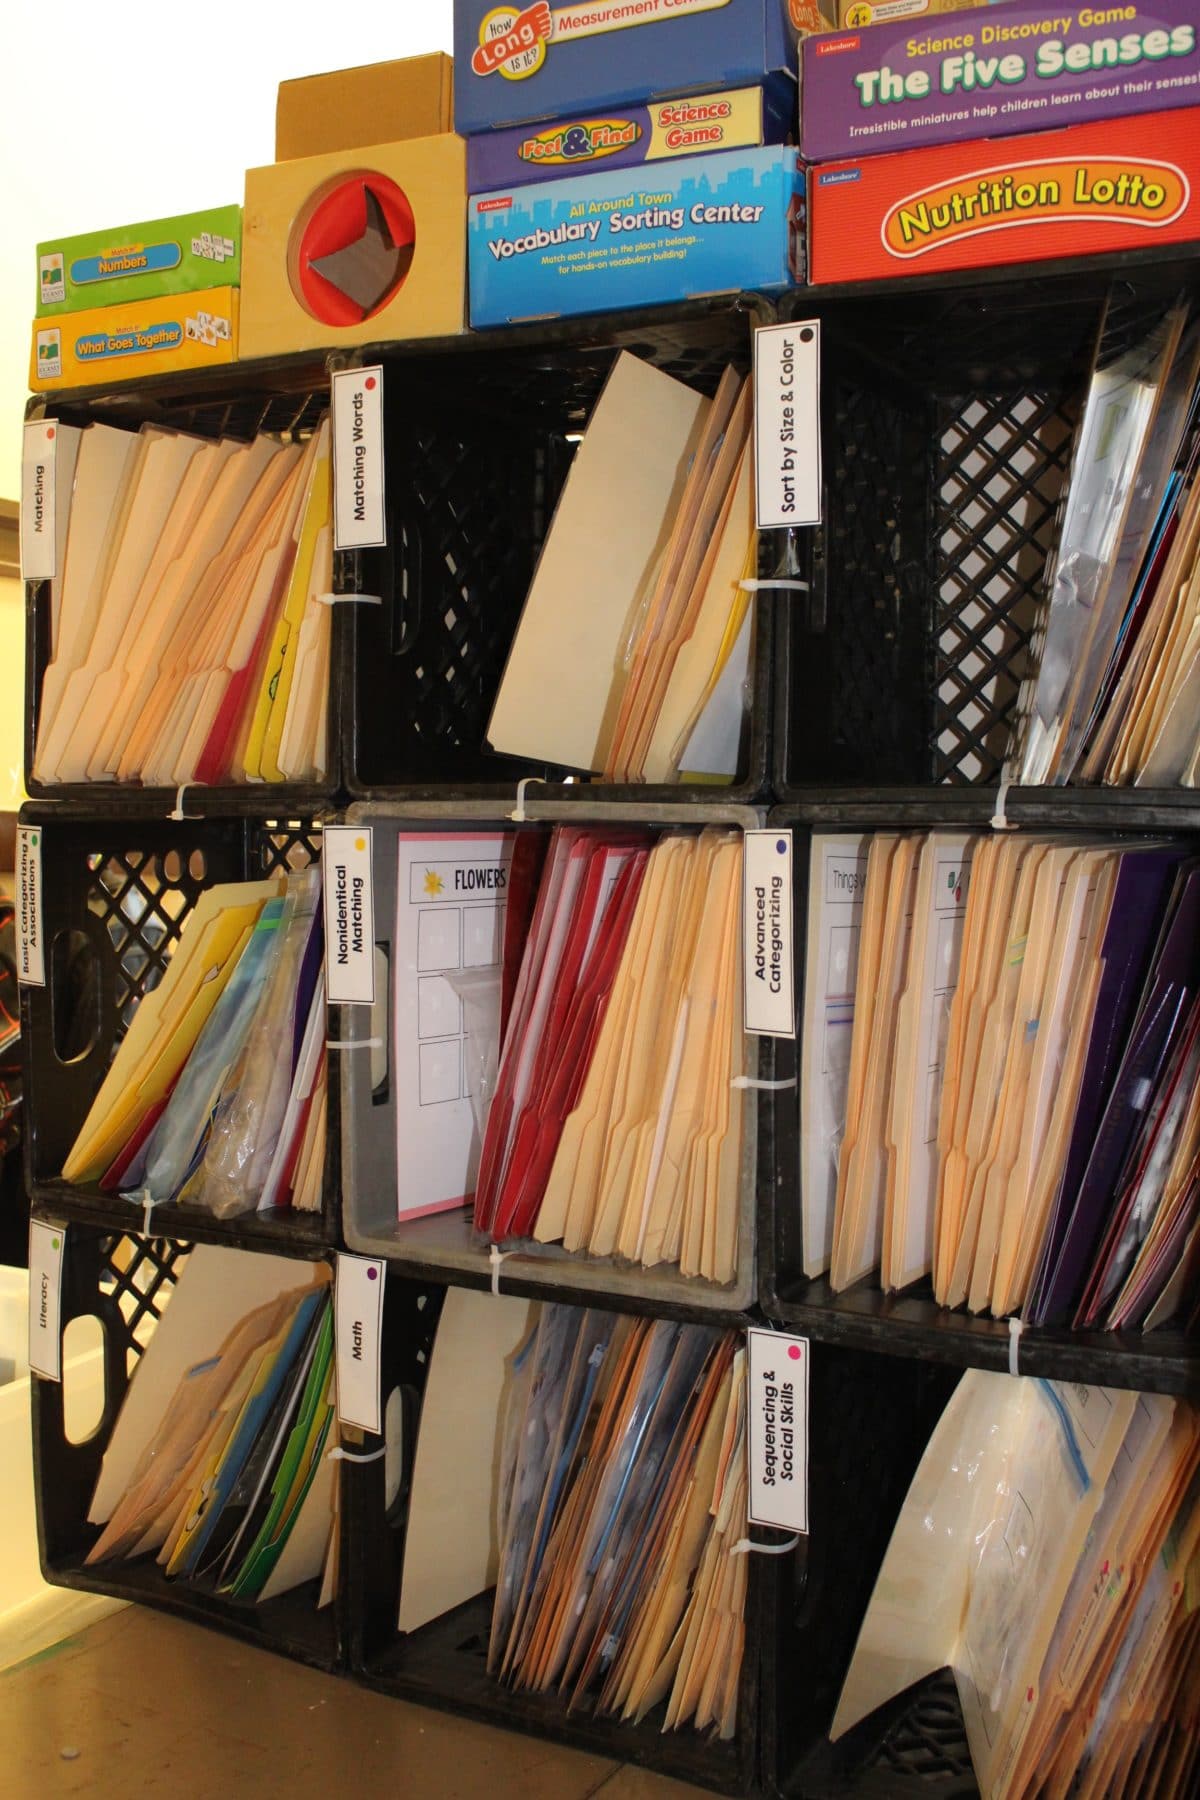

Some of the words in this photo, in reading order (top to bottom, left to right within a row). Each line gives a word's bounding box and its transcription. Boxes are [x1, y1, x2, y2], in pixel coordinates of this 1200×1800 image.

[489, 18, 513, 36] How
[559, 0, 659, 31] Measurement
[906, 33, 974, 57] Science
[981, 14, 1072, 46] Discovery
[1078, 6, 1137, 28] Game
[480, 24, 535, 66] Long
[854, 65, 932, 107] The
[940, 49, 1026, 94] Five
[1036, 24, 1195, 76] Senses
[659, 101, 732, 127] Science
[849, 118, 907, 138] Irresistible
[911, 108, 970, 128] miniatures
[973, 103, 998, 122] help
[1001, 95, 1048, 114] children
[1051, 88, 1082, 105] learn
[1085, 84, 1121, 100] about
[1124, 80, 1153, 95] their
[523, 139, 561, 159] Feel
[562, 126, 592, 158] &
[591, 121, 636, 146] Find
[666, 124, 723, 149] Game
[569, 204, 585, 218] All
[588, 196, 634, 215] Around
[638, 193, 673, 207] Town
[898, 176, 1060, 243] Nutrition
[1073, 169, 1167, 210] Lotto
[488, 220, 601, 260] Vocabulary
[609, 206, 685, 233] Sorting
[690, 202, 765, 225] Center
[541, 254, 566, 265] Match
[567, 252, 586, 262] each
[588, 249, 608, 261] piece
[610, 247, 618, 255] to
[620, 244, 633, 254] the
[635, 241, 656, 253] place
[658, 238, 663, 247] it
[98, 254, 147, 275] Numbers
[559, 265, 570, 275] for
[572, 260, 608, 273] hands-on
[609, 253, 651, 267] vocabulary
[654, 249, 687, 261] building!
[78, 340, 105, 356] What
[107, 335, 133, 351] Goes
[136, 328, 180, 349] Together
[780, 339, 794, 386] Color
[352, 392, 363, 442] Words
[781, 391, 793, 402] &
[780, 407, 794, 441] Size
[781, 447, 797, 471] by
[34, 465, 45, 533] Matching
[353, 446, 367, 521] Matching
[782, 476, 795, 513] Sort
[21, 832, 28, 841] &
[20, 843, 29, 933] Categorizing
[455, 868, 507, 890] FLOWERS
[833, 870, 858, 893] Things
[28, 859, 36, 948] Associations
[335, 865, 348, 965] Nonidentical
[350, 877, 364, 953] Matching
[755, 887, 766, 981] Advanced
[769, 876, 783, 994] Categorizing
[40, 1272, 50, 1329] Literacy
[352, 1321, 362, 1361] Math
[763, 1370, 776, 1381] &
[780, 1382, 794, 1424] Skills
[762, 1385, 778, 1487] Sequencing
[780, 1428, 794, 1481] Social
